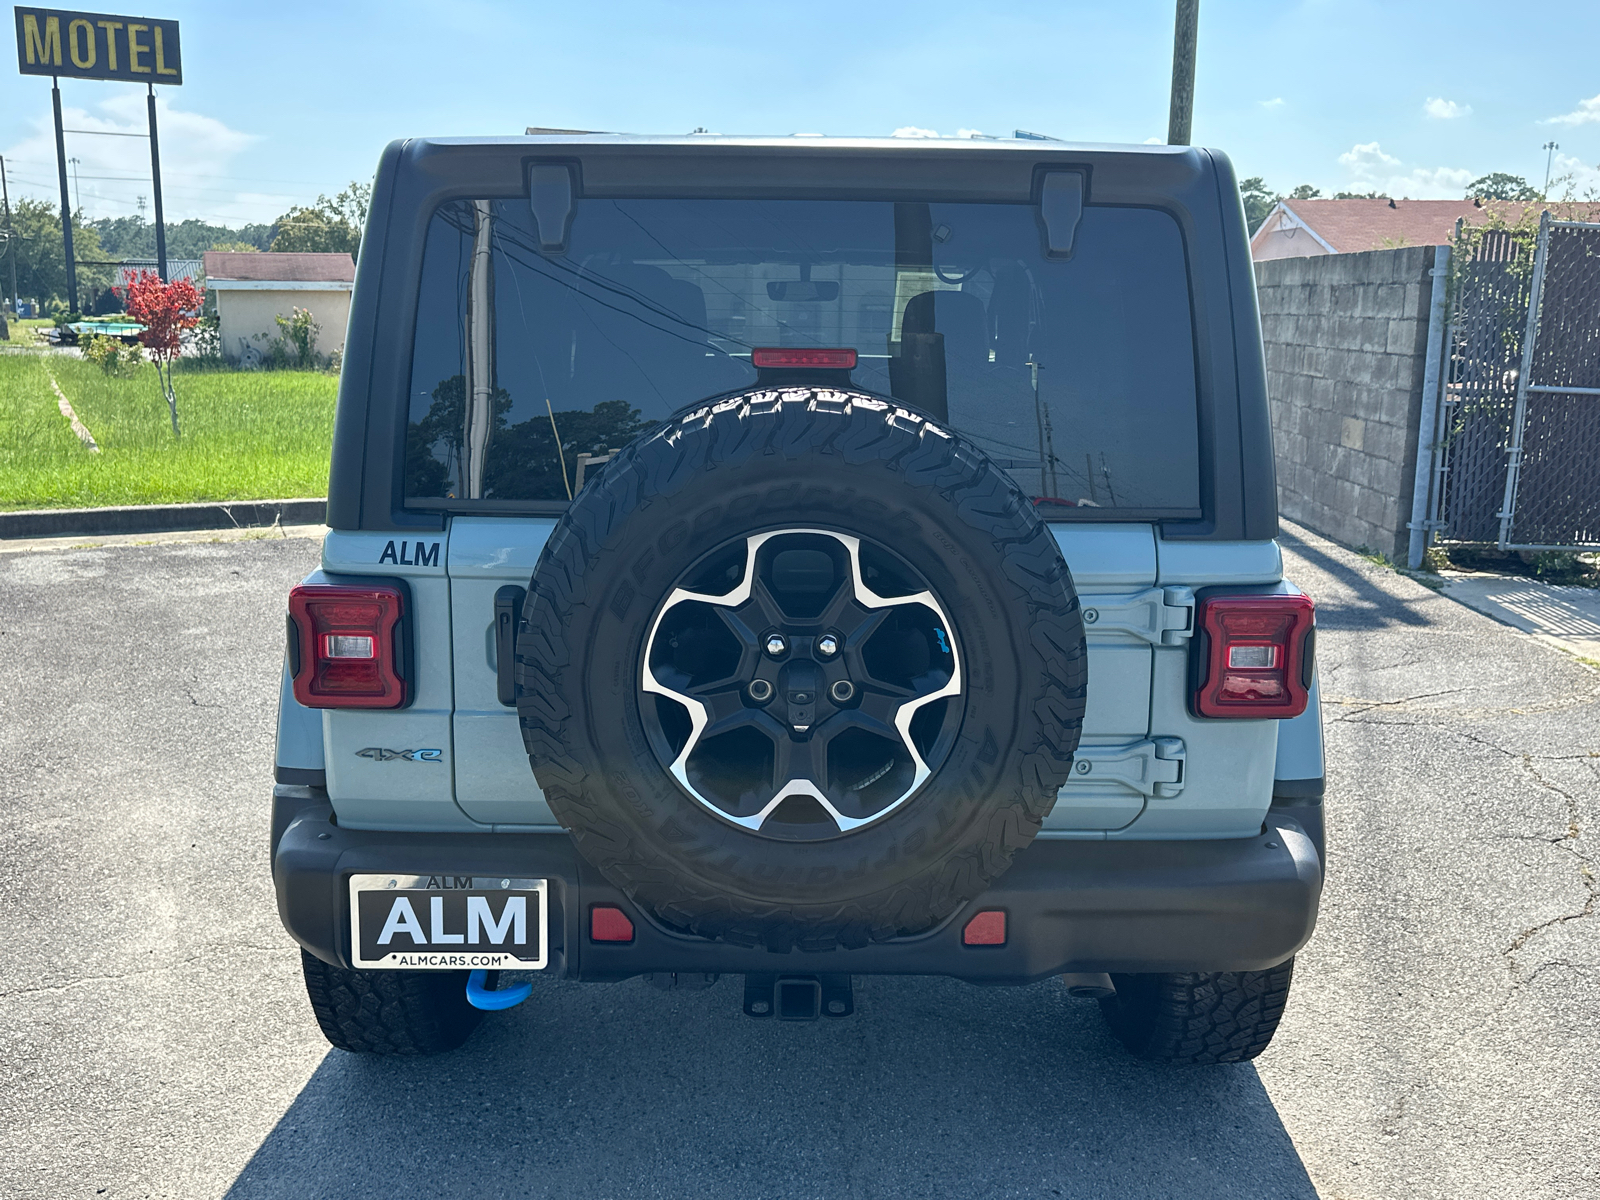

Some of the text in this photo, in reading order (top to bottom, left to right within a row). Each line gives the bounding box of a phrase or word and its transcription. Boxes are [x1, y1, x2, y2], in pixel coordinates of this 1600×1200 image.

[22, 14, 178, 76] MOTEL
[378, 540, 441, 567] ALM
[609, 482, 922, 622] BFGoodrich
[426, 876, 474, 890] ALM
[376, 896, 527, 945] ALM
[399, 956, 502, 966] ALMCARS.COM
